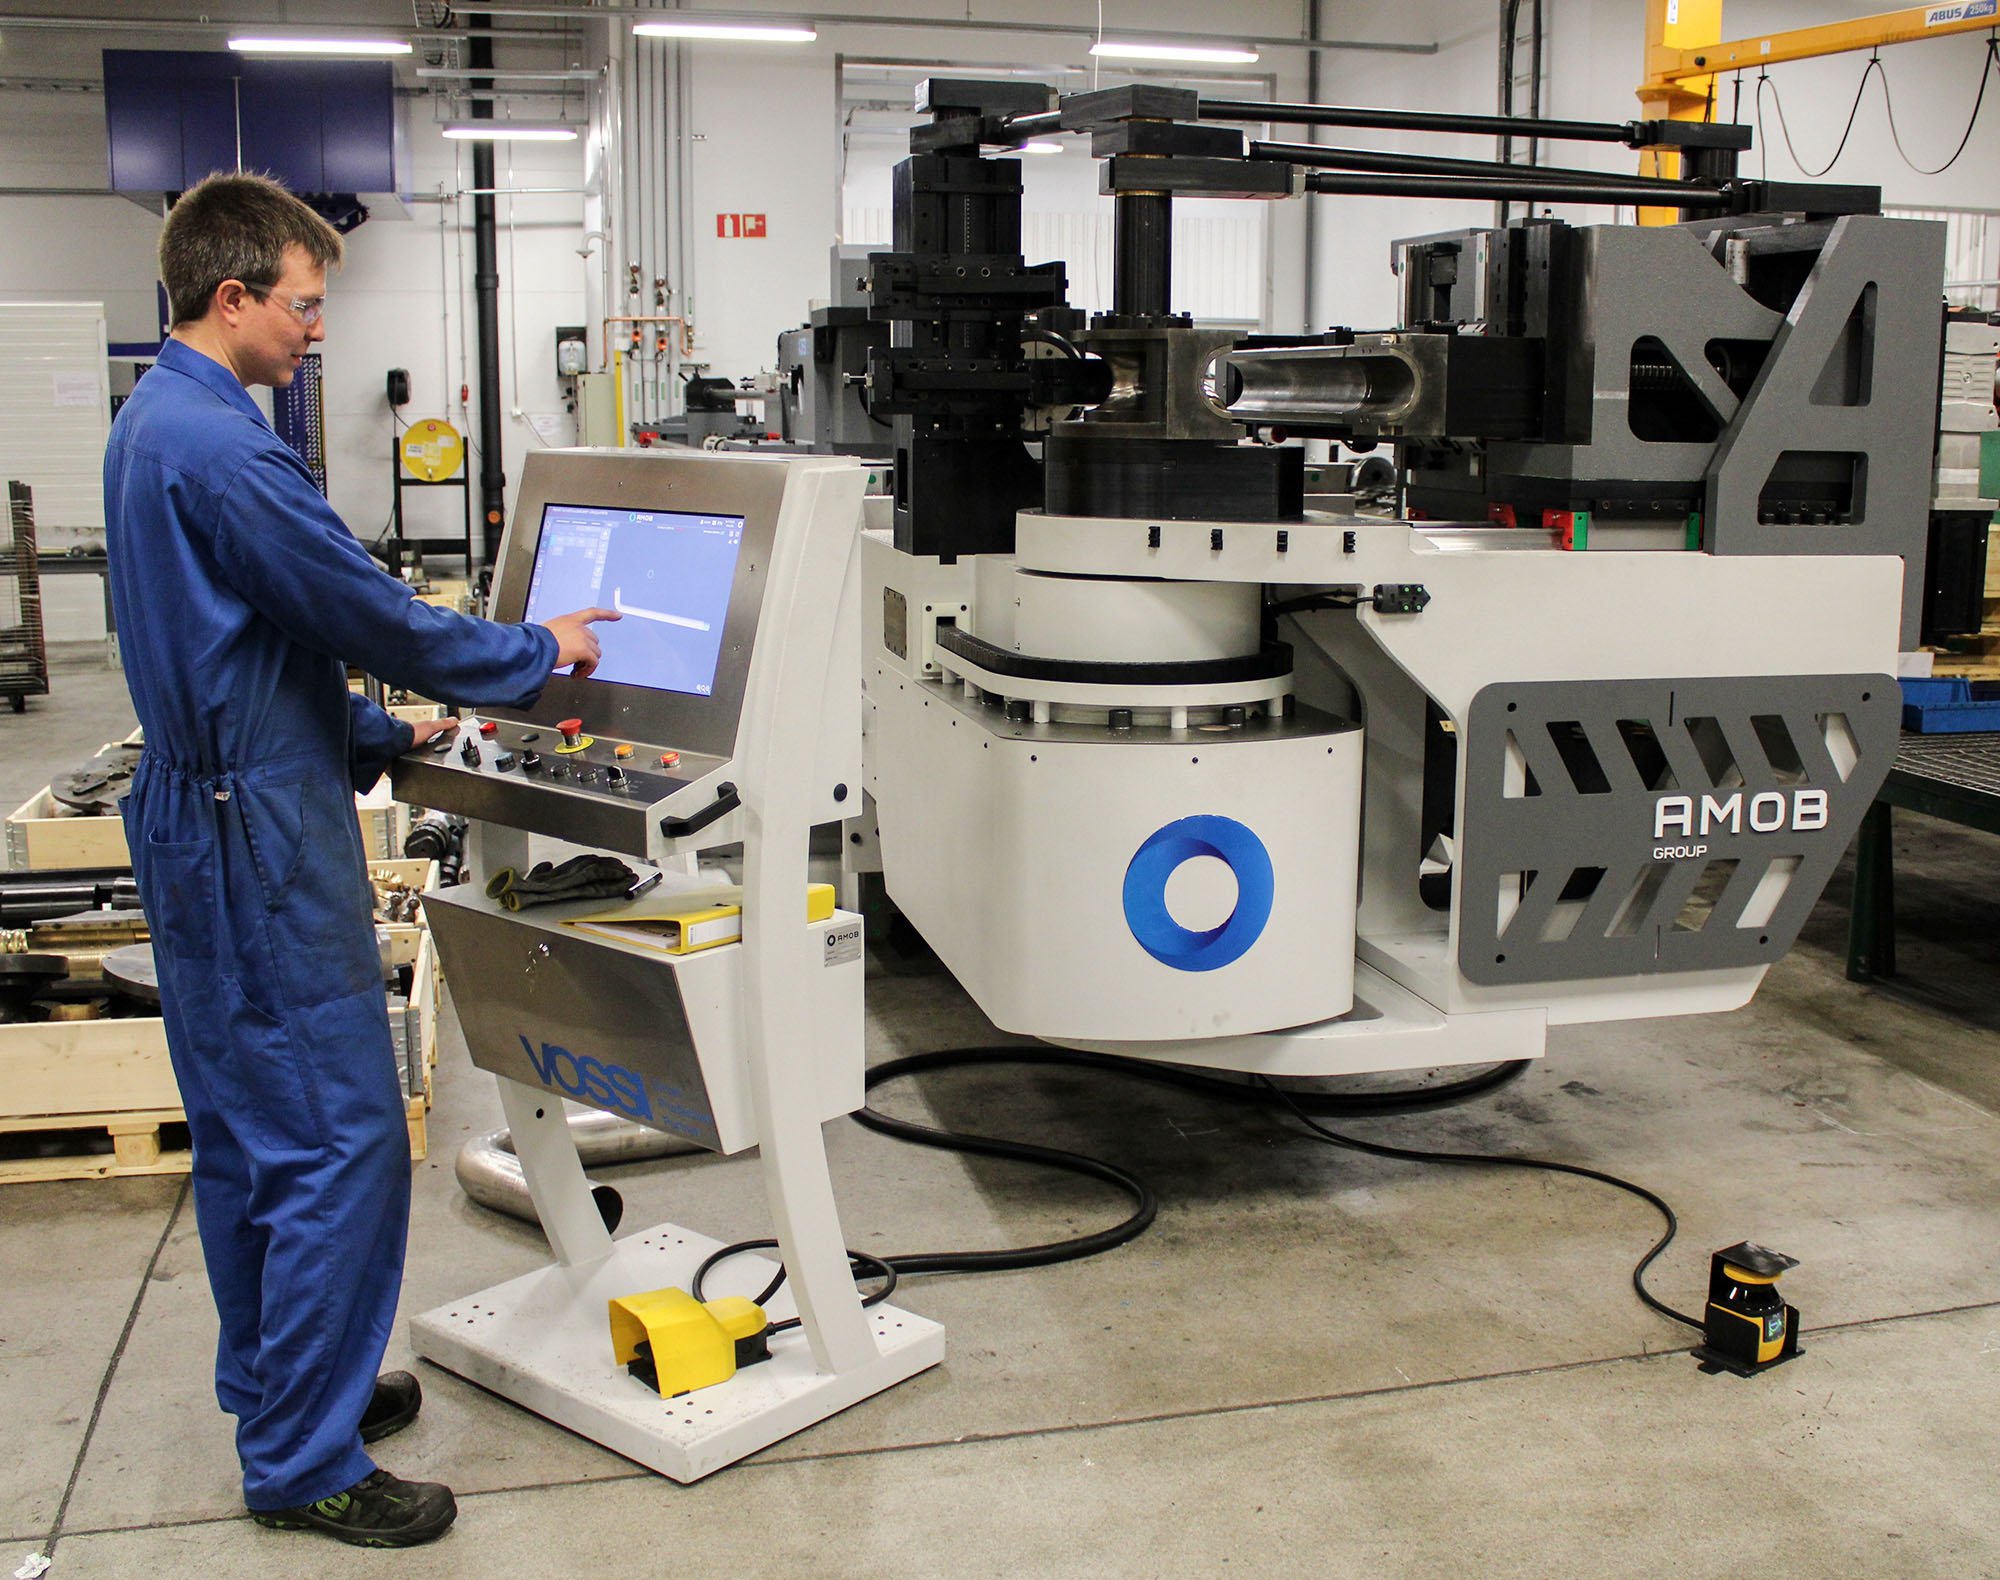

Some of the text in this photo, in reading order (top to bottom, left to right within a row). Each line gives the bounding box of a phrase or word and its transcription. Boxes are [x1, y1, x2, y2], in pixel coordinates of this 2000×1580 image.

[1928, 4, 1994, 22] ABUS 250kg
[1653, 789, 1829, 838] AMOB
[1652, 845, 1708, 860] GROUP
[837, 931, 859, 942] AMOB
[519, 1034, 655, 1121] VOSSI
